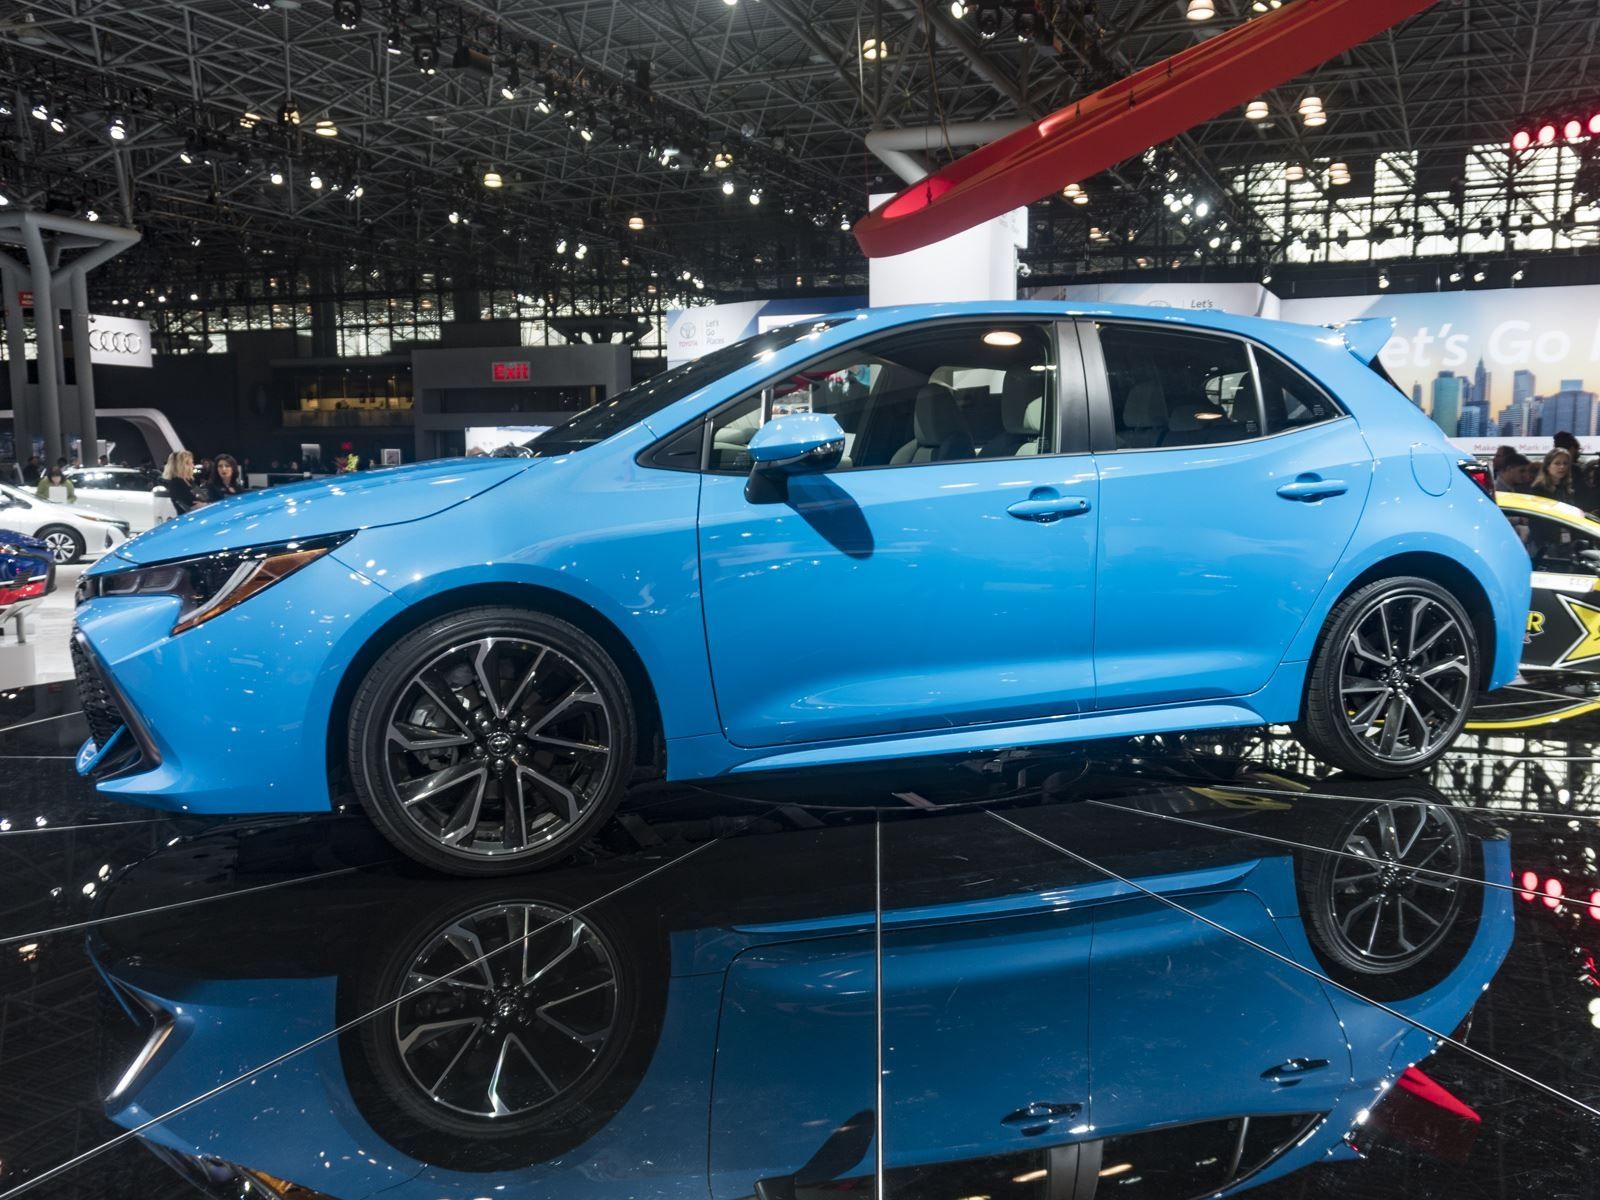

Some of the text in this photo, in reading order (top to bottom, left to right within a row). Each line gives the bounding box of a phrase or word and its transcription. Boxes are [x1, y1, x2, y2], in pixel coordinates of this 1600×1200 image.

[1190, 299, 1213, 309] Let's
[678, 339, 698, 348] TOYOTA
[1382, 322, 1470, 368] et's
[1489, 319, 1571, 365] Go
[494, 362, 529, 380] Exit
